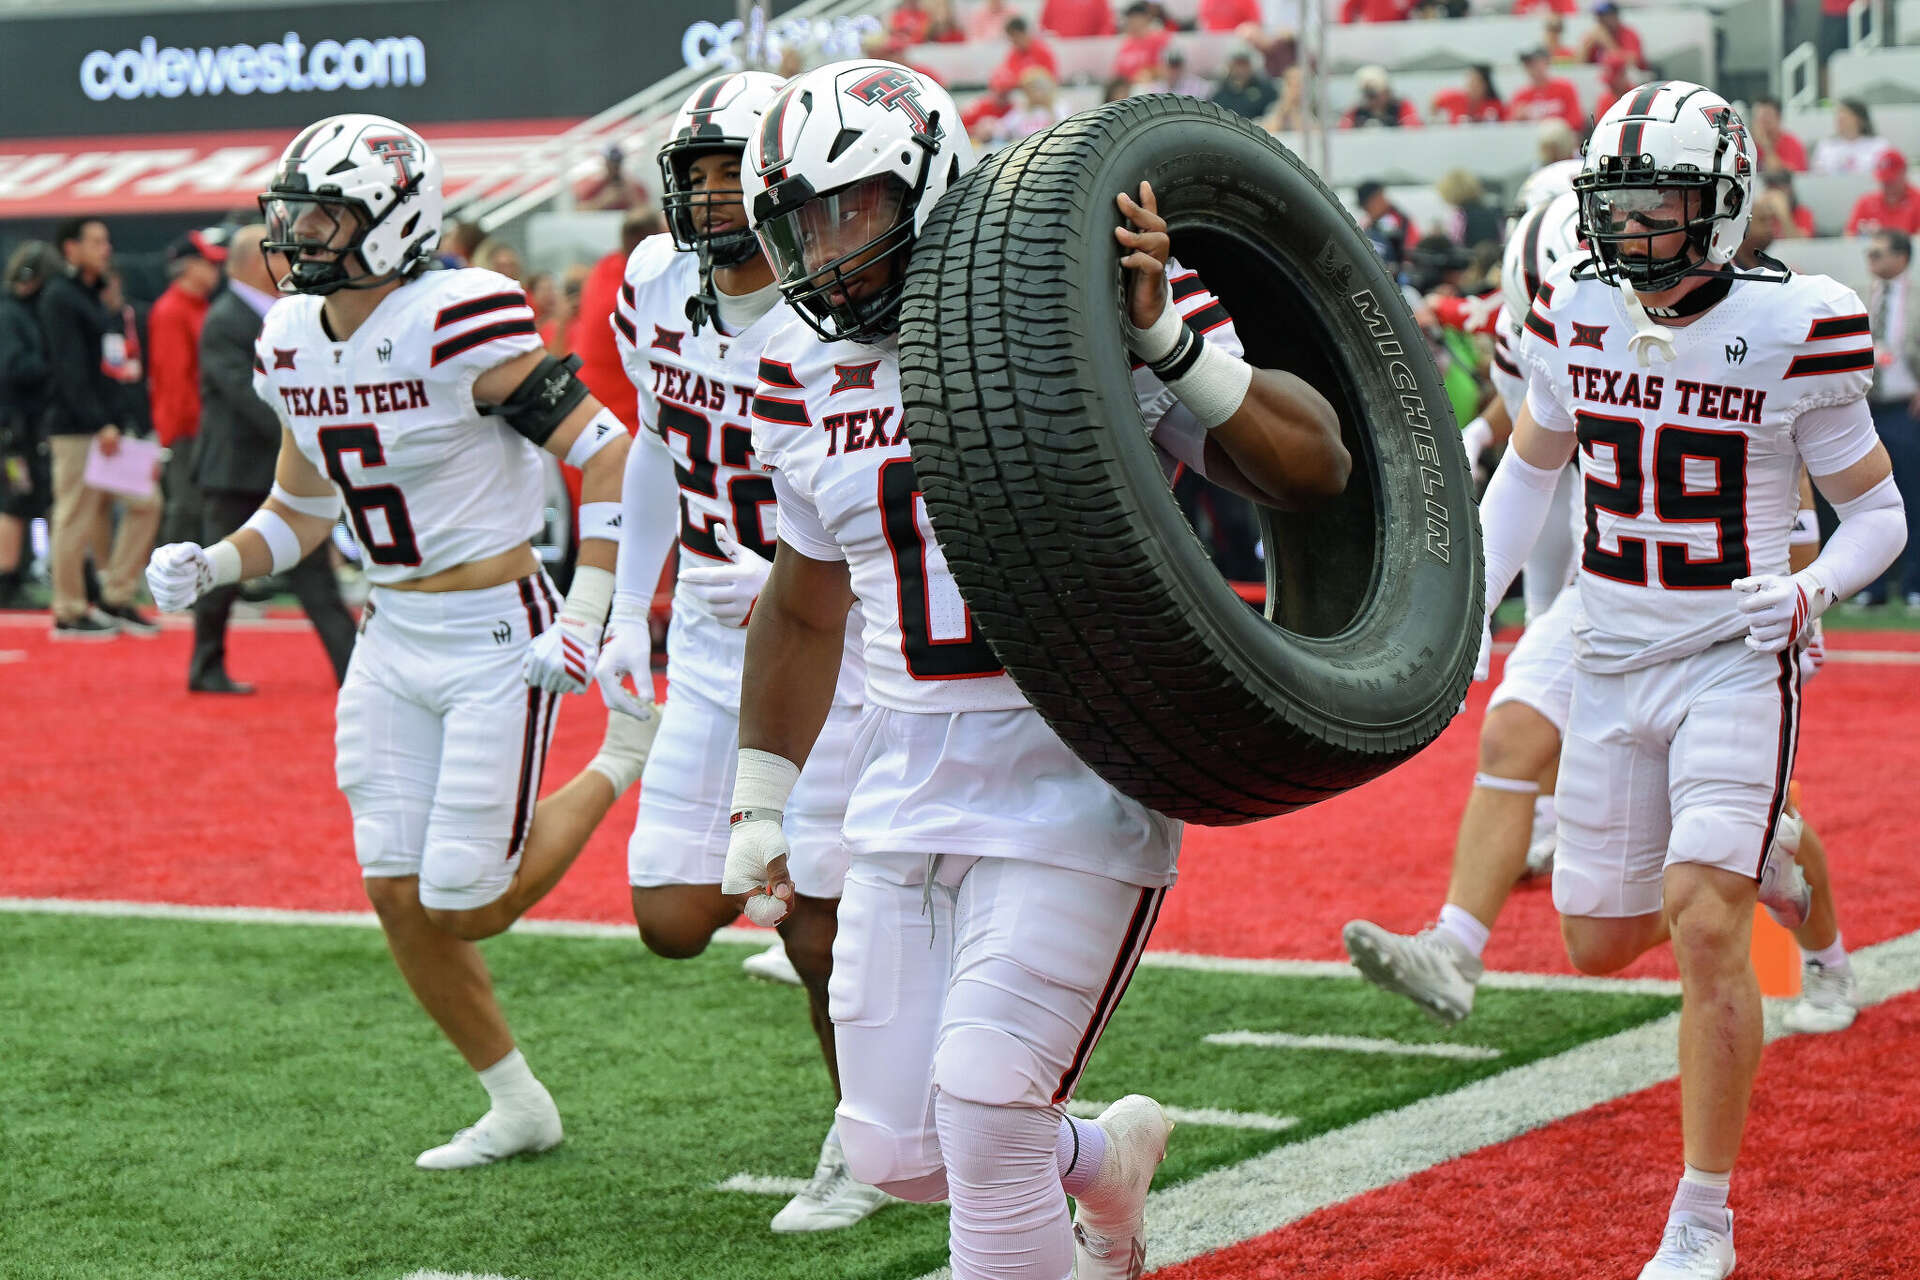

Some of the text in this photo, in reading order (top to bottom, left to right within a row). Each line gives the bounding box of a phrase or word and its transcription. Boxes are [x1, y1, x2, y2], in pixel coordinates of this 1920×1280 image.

[80, 31, 426, 101] colewest.com
[279, 379, 430, 416] TEXAS TECH
[649, 360, 726, 411] TEXAS
[1568, 364, 1767, 424] TEXAS TECH
[822, 406, 909, 457] TEXA
[1352, 289, 1449, 563] MICHELIN
[317, 422, 423, 567] 6
[1575, 409, 1751, 591] 29
